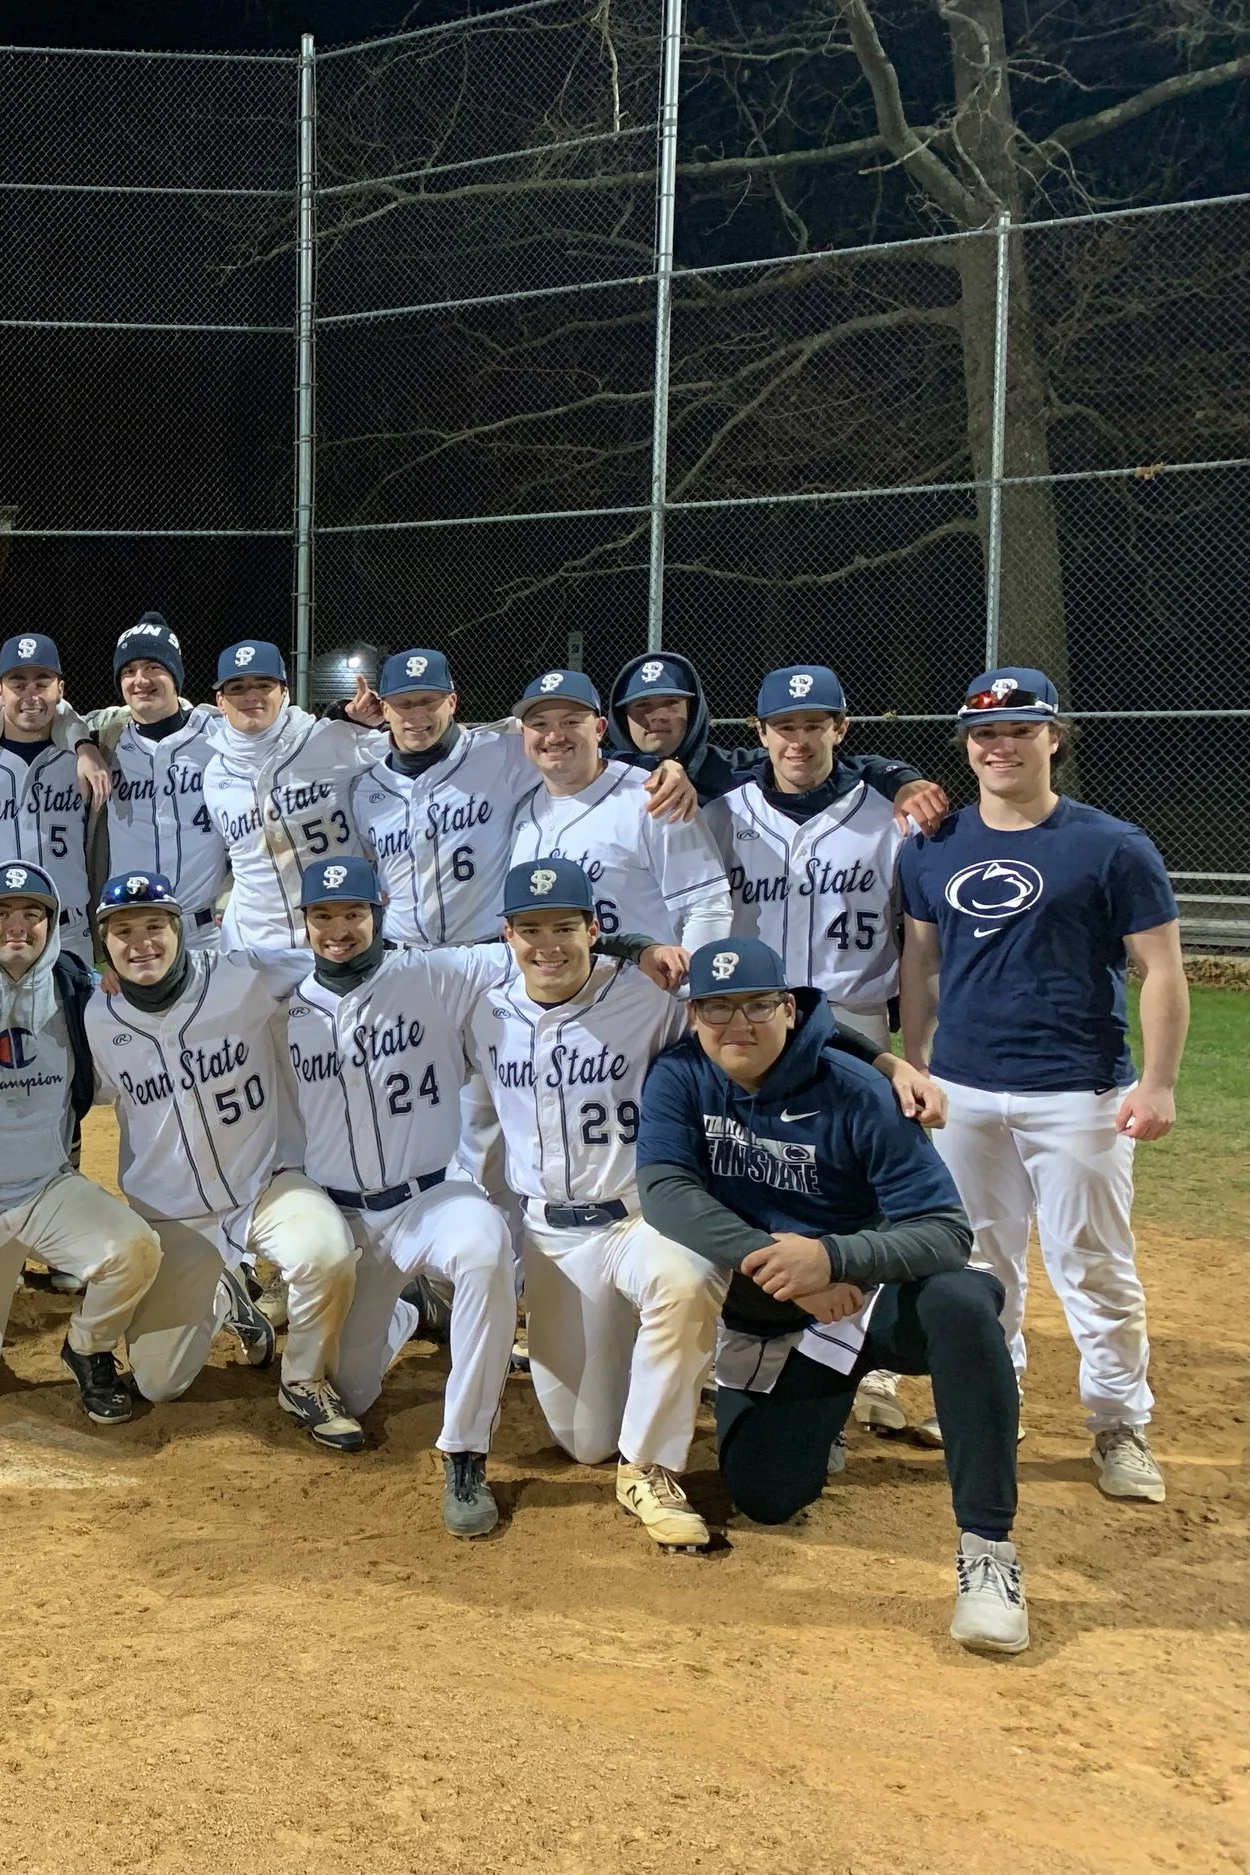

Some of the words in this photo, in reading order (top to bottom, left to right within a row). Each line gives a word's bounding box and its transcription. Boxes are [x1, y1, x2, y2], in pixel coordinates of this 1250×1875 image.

[28, 782, 83, 813] State
[109, 770, 157, 801] Penn
[164, 765, 203, 796] Sta
[221, 807, 263, 840] Penn
[270, 782, 331, 821] State
[301, 809, 350, 855] 53
[368, 827, 413, 859] Penn
[426, 794, 493, 840] State
[50, 825, 68, 858] 5
[452, 845, 476, 882] 6
[730, 865, 791, 904] Penn
[799, 857, 876, 896] State
[826, 910, 879, 951] 45
[120, 1071, 174, 1105] Penn
[180, 1037, 250, 1090] State
[290, 1043, 344, 1083] Penn
[352, 1014, 425, 1067] State
[488, 1045, 538, 1088] Penn
[546, 1044, 630, 1088] State
[214, 1073, 266, 1126] 50
[386, 1063, 440, 1116] 24
[579, 1100, 641, 1145] 29
[708, 1139, 746, 1176] ENN
[748, 1149, 823, 1194] STATE
